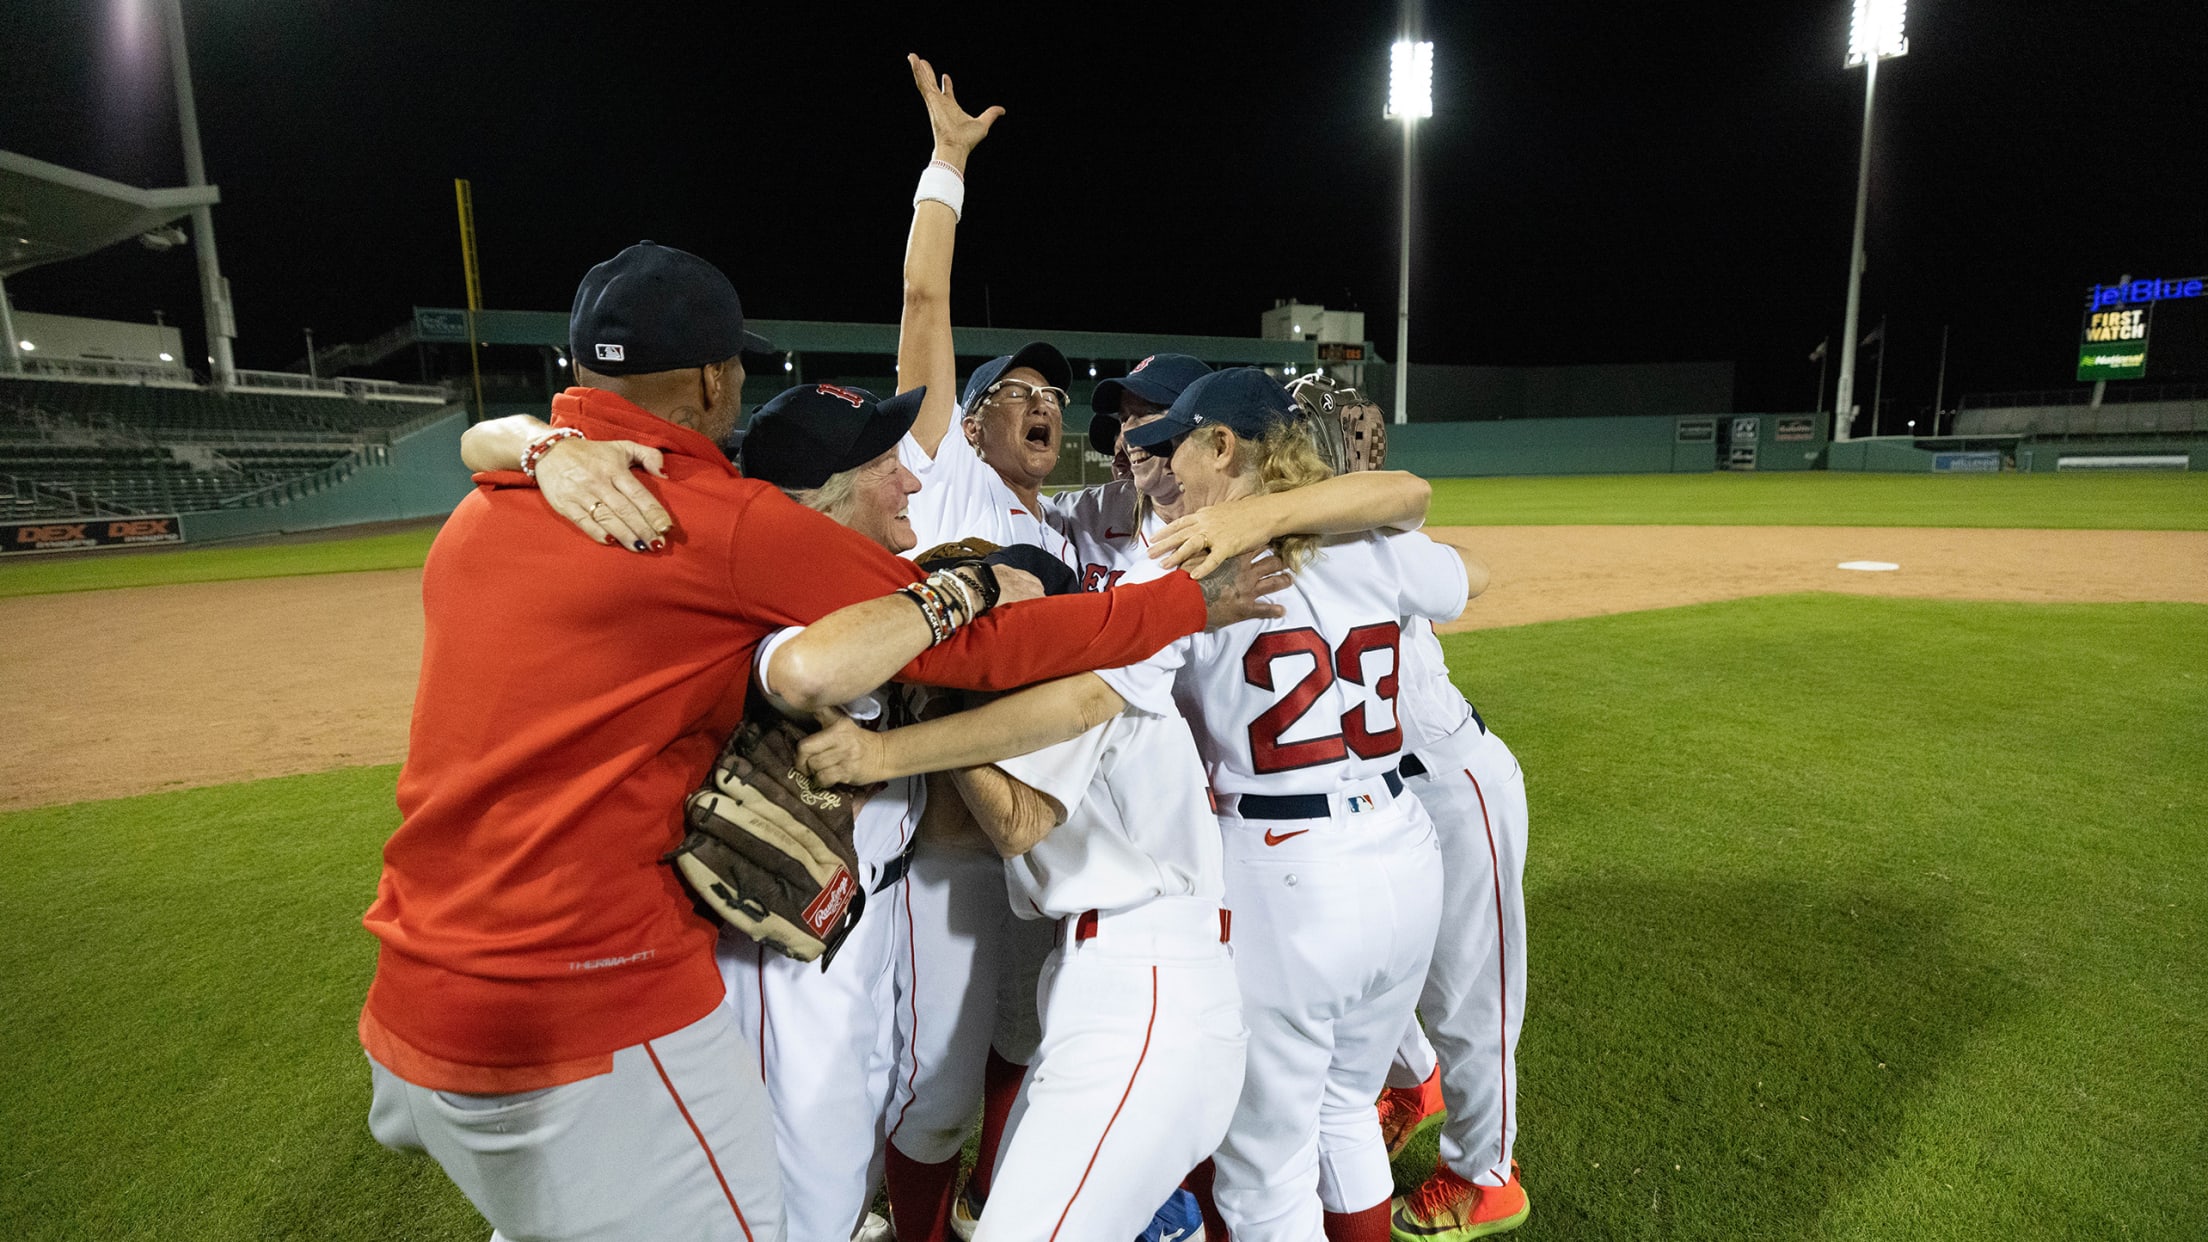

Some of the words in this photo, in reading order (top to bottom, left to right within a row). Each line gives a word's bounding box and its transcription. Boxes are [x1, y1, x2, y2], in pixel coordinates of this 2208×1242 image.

[2091, 278, 2203, 312] jetBlue
[2091, 310, 2143, 327] FIRST
[2086, 323, 2146, 342] WATCH
[17, 524, 87, 543] DEX
[108, 520, 170, 538] DEX
[921, 603, 939, 628] BLACK
[1242, 620, 1404, 775] 23
[815, 876, 849, 928] Rawlings
